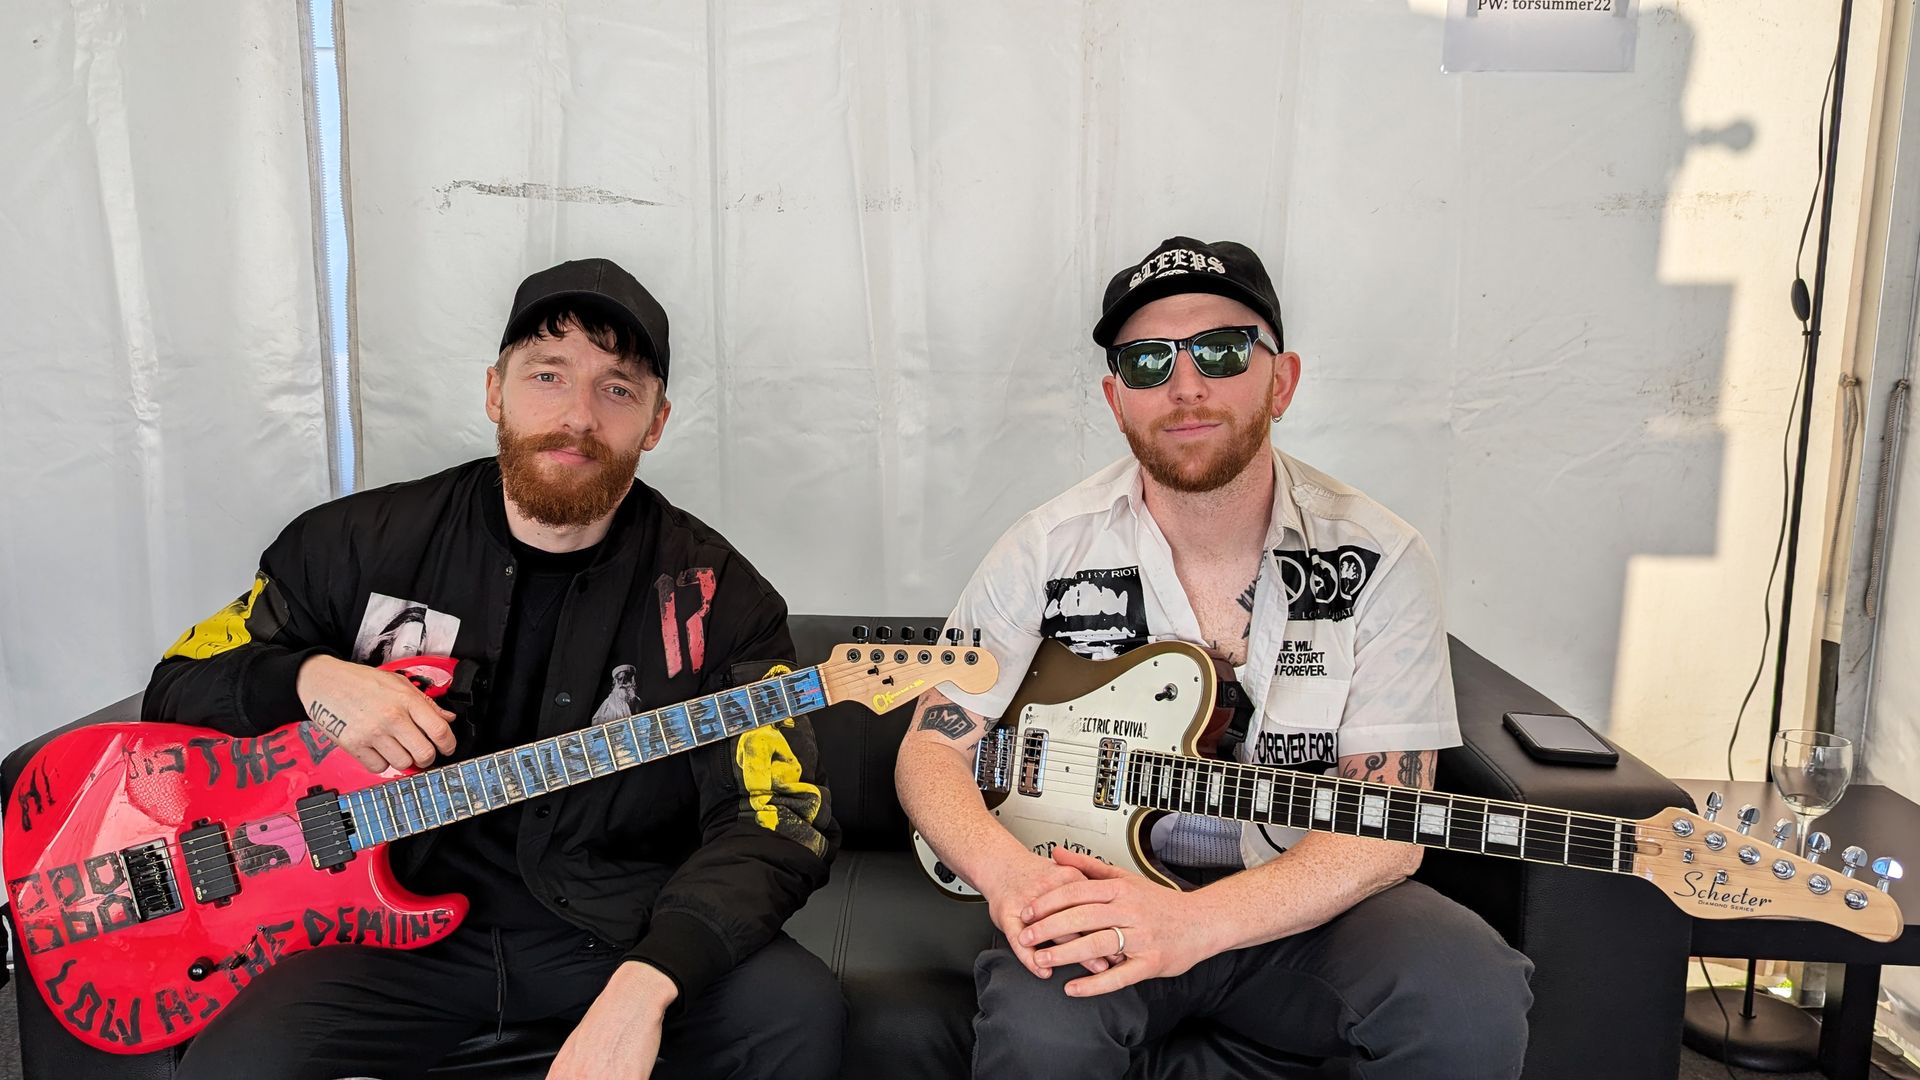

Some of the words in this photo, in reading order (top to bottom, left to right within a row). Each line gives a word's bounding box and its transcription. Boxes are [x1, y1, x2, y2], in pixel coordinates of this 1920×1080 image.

[1477, 0, 1508, 11] PW:
[1513, 0, 1611, 11] torsummer22
[1111, 567, 1138, 578] RIOT
[1294, 640, 1313, 652] WILL
[1296, 652, 1325, 664] START
[1280, 665, 1328, 677] FOREVER.
[928, 709, 968, 735] PMA
[1308, 732, 1335, 763] FOR
[188, 729, 298, 790] THE
[1674, 871, 1769, 907] Schecter
[45, 959, 143, 1047] LOW
[155, 986, 222, 1036] AS
